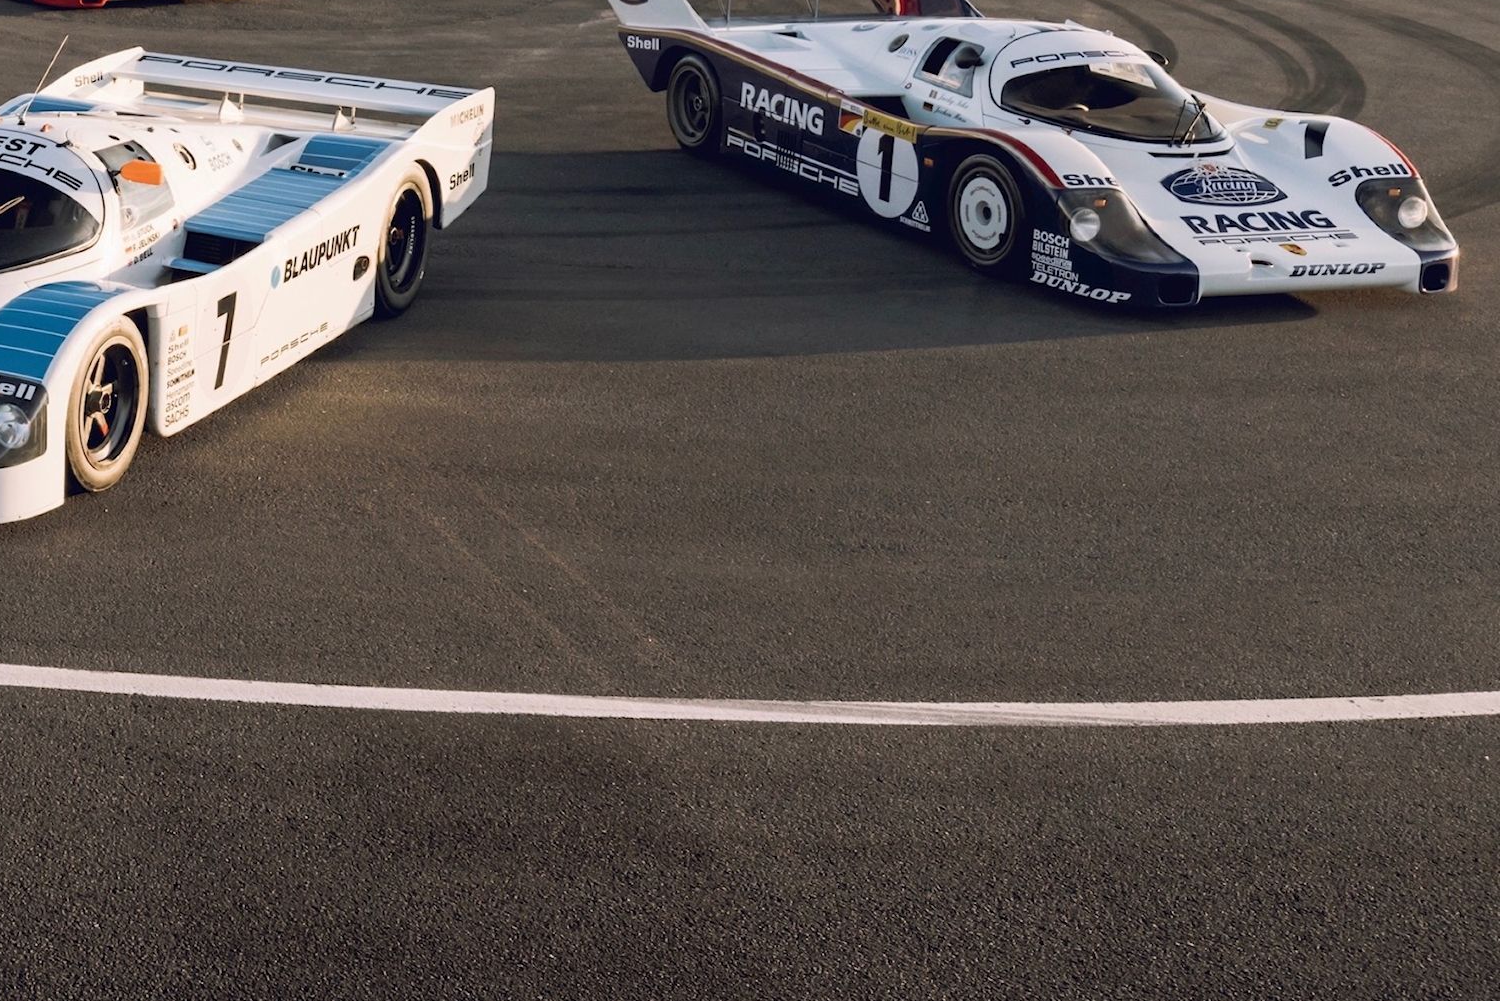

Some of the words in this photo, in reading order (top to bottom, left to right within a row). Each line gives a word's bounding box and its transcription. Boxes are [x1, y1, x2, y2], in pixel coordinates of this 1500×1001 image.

[627, 35, 660, 51] Shell
[75, 72, 103, 87] Shell
[138, 55, 473, 99] PORSCHE
[450, 104, 485, 128] MICHELIN
[740, 81, 824, 136] RACING
[1298, 119, 1330, 160] 1
[450, 163, 475, 191] Shell
[878, 133, 895, 203] 1
[1328, 163, 1409, 188] Shell
[1196, 176, 1258, 195] Racing
[1180, 209, 1337, 234] RACING
[1031, 239, 1069, 260] BILSTEIN
[1032, 228, 1070, 249] BOSCH
[1198, 233, 1360, 246] PORSCHE
[283, 225, 361, 284] BLAUPUNKT
[1031, 259, 1079, 282] TELETRON
[1289, 262, 1387, 278] DUNLOP
[1030, 272, 1132, 304] DUNLOP
[168, 338, 189, 354] Shell
[260, 321, 329, 367] PORSCHE
[167, 350, 187, 366] BOSCH
[165, 391, 191, 413] ascom
[164, 407, 190, 428] SACHS
